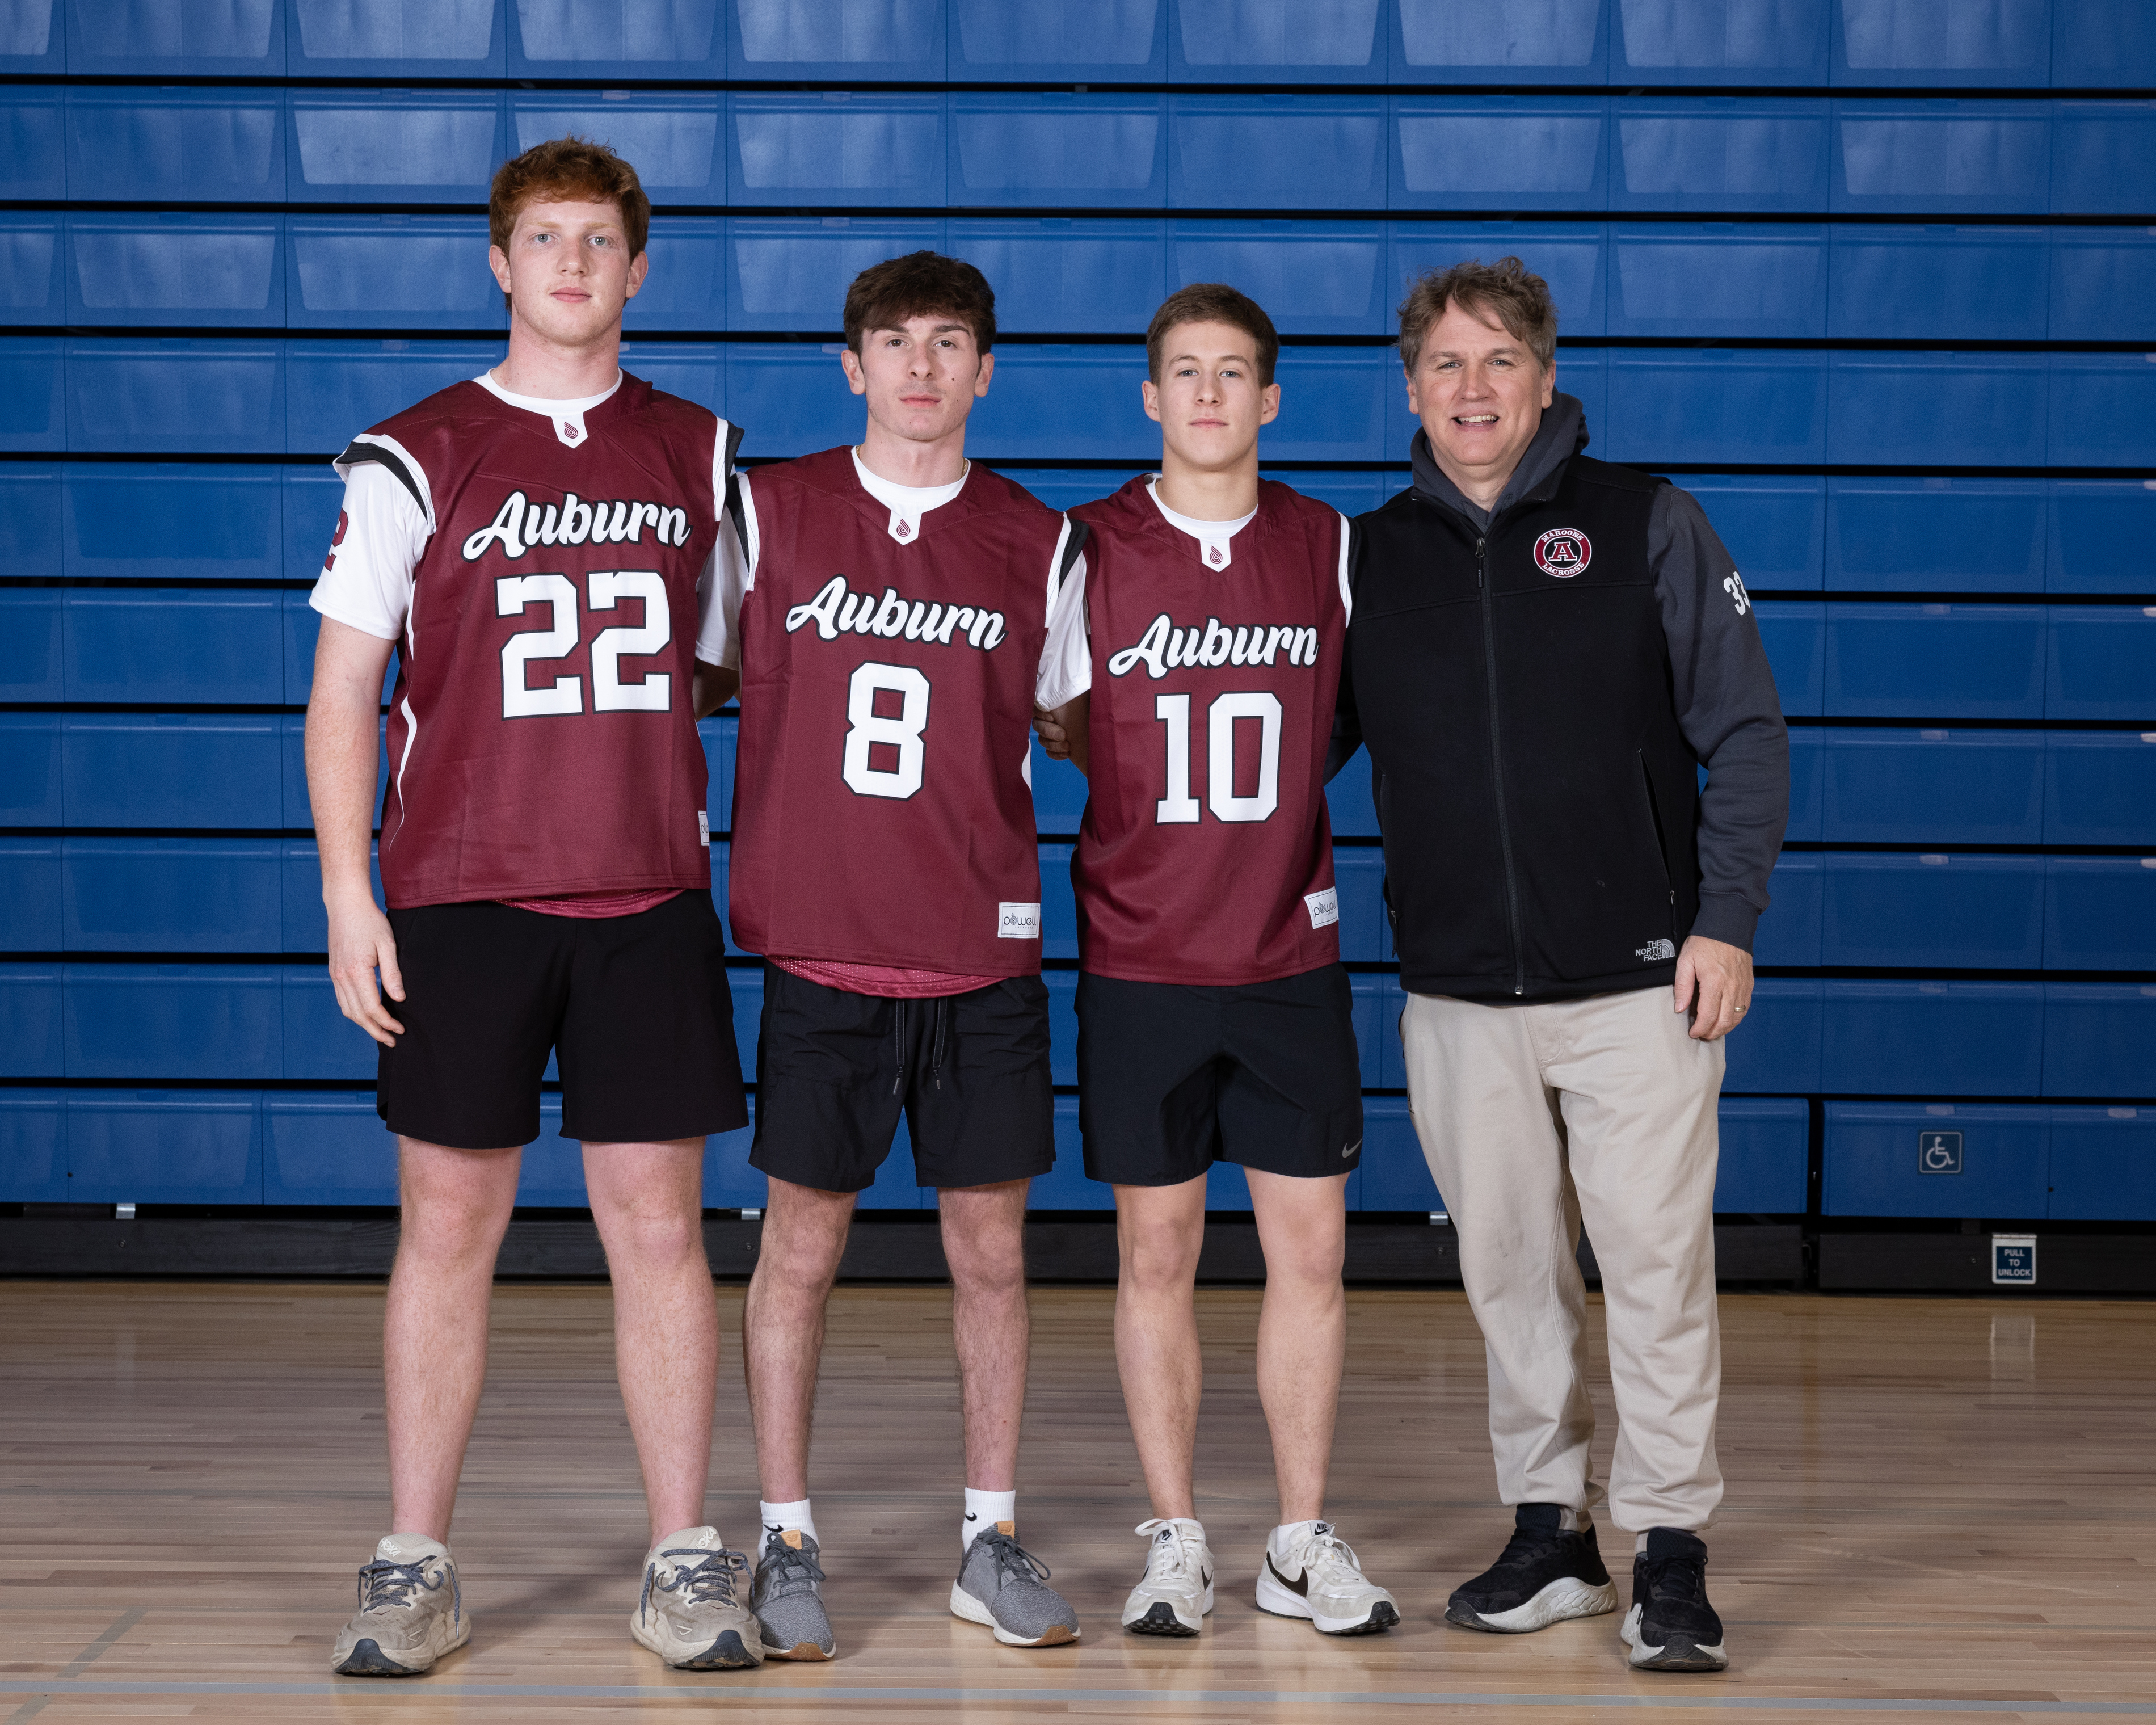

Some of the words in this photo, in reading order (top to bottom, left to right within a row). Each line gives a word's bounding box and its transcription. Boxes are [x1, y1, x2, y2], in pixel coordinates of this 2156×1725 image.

[461, 489, 692, 563] Auburn
[1540, 529, 1584, 543] MAROONS
[1548, 541, 1578, 562] A
[1542, 562, 1585, 576] LACROSSE
[783, 573, 1009, 653] Auburn
[495, 569, 672, 721] 22
[1106, 612, 1321, 681] Auburn
[841, 660, 932, 802] 8
[1155, 690, 1284, 825] 10
[1003, 912, 1037, 927] powell
[1635, 946, 1662, 956] NORTH
[1647, 939, 1662, 948] THE
[1643, 952, 1662, 962] FACE
[378, 1537, 401, 1557] HOKA
